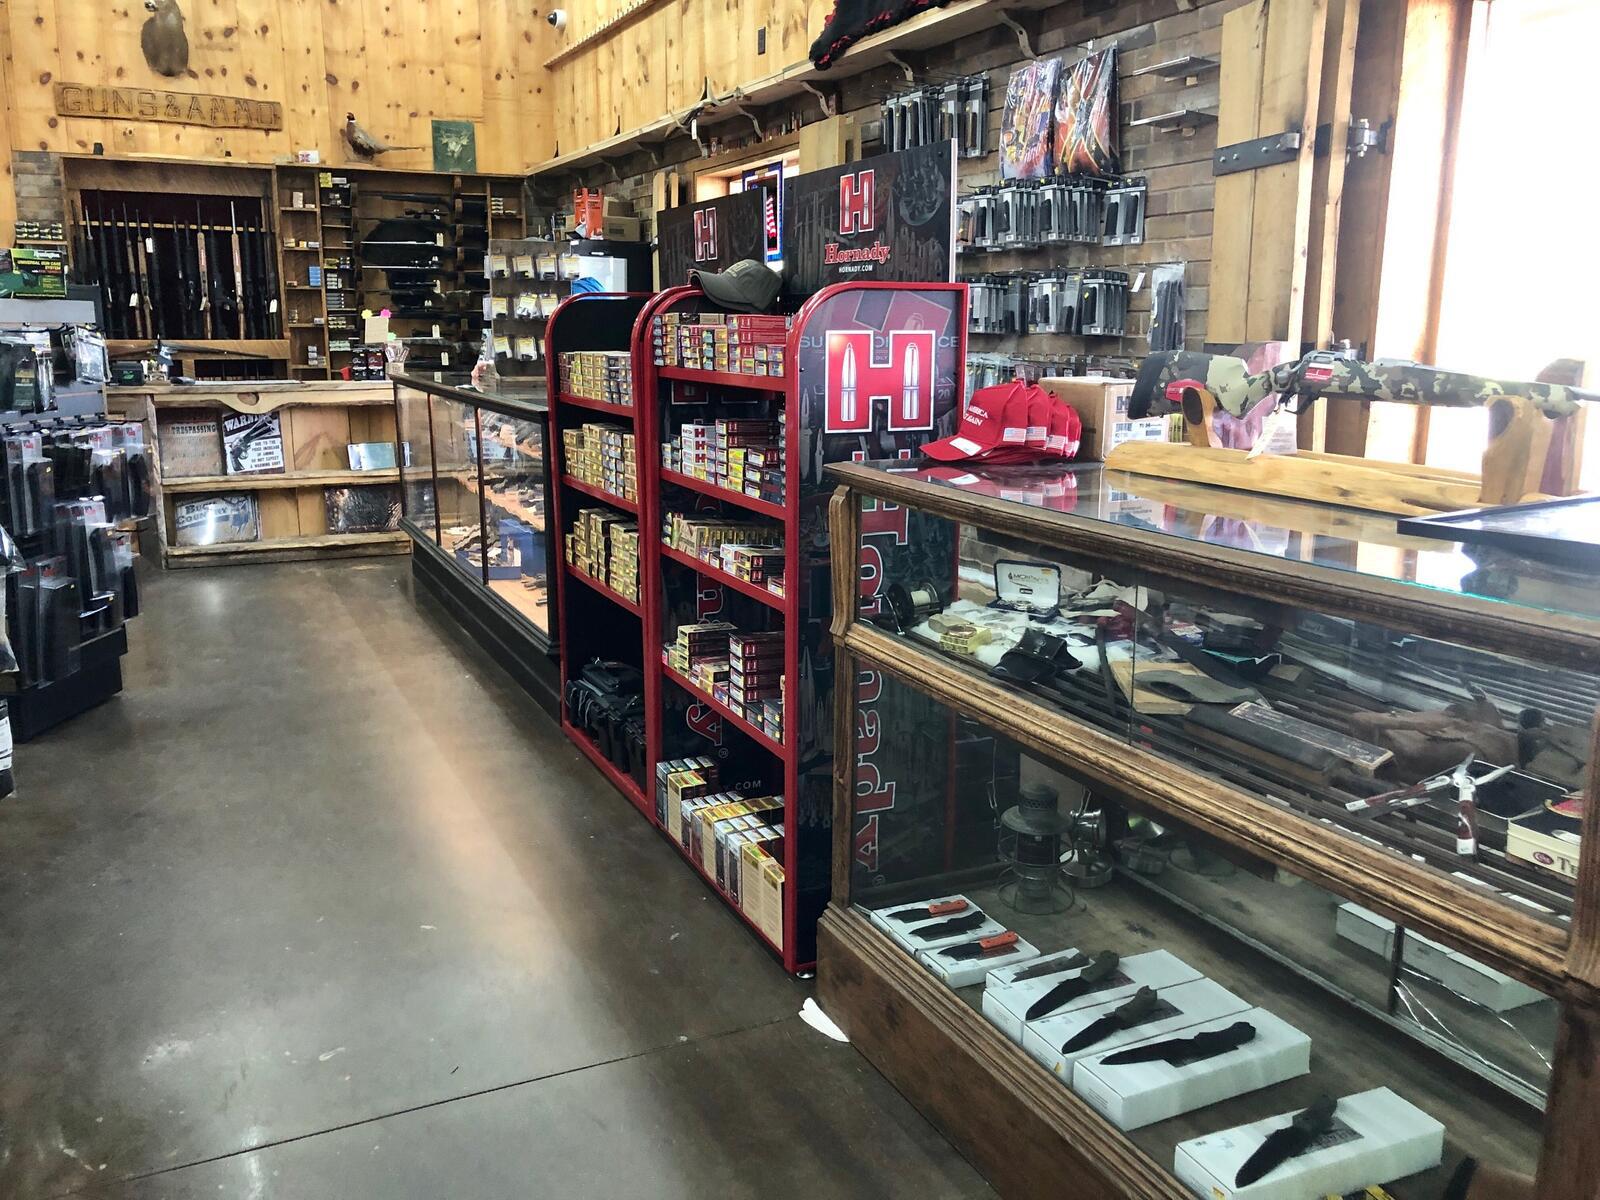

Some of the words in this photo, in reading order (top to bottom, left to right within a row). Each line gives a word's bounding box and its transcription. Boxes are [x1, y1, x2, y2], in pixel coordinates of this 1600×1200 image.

[824, 241, 890, 264] Hornady
[838, 264, 873, 273] HORNADY.COM
[825, 329, 936, 434] H
[171, 424, 216, 435] TRESPASSING
